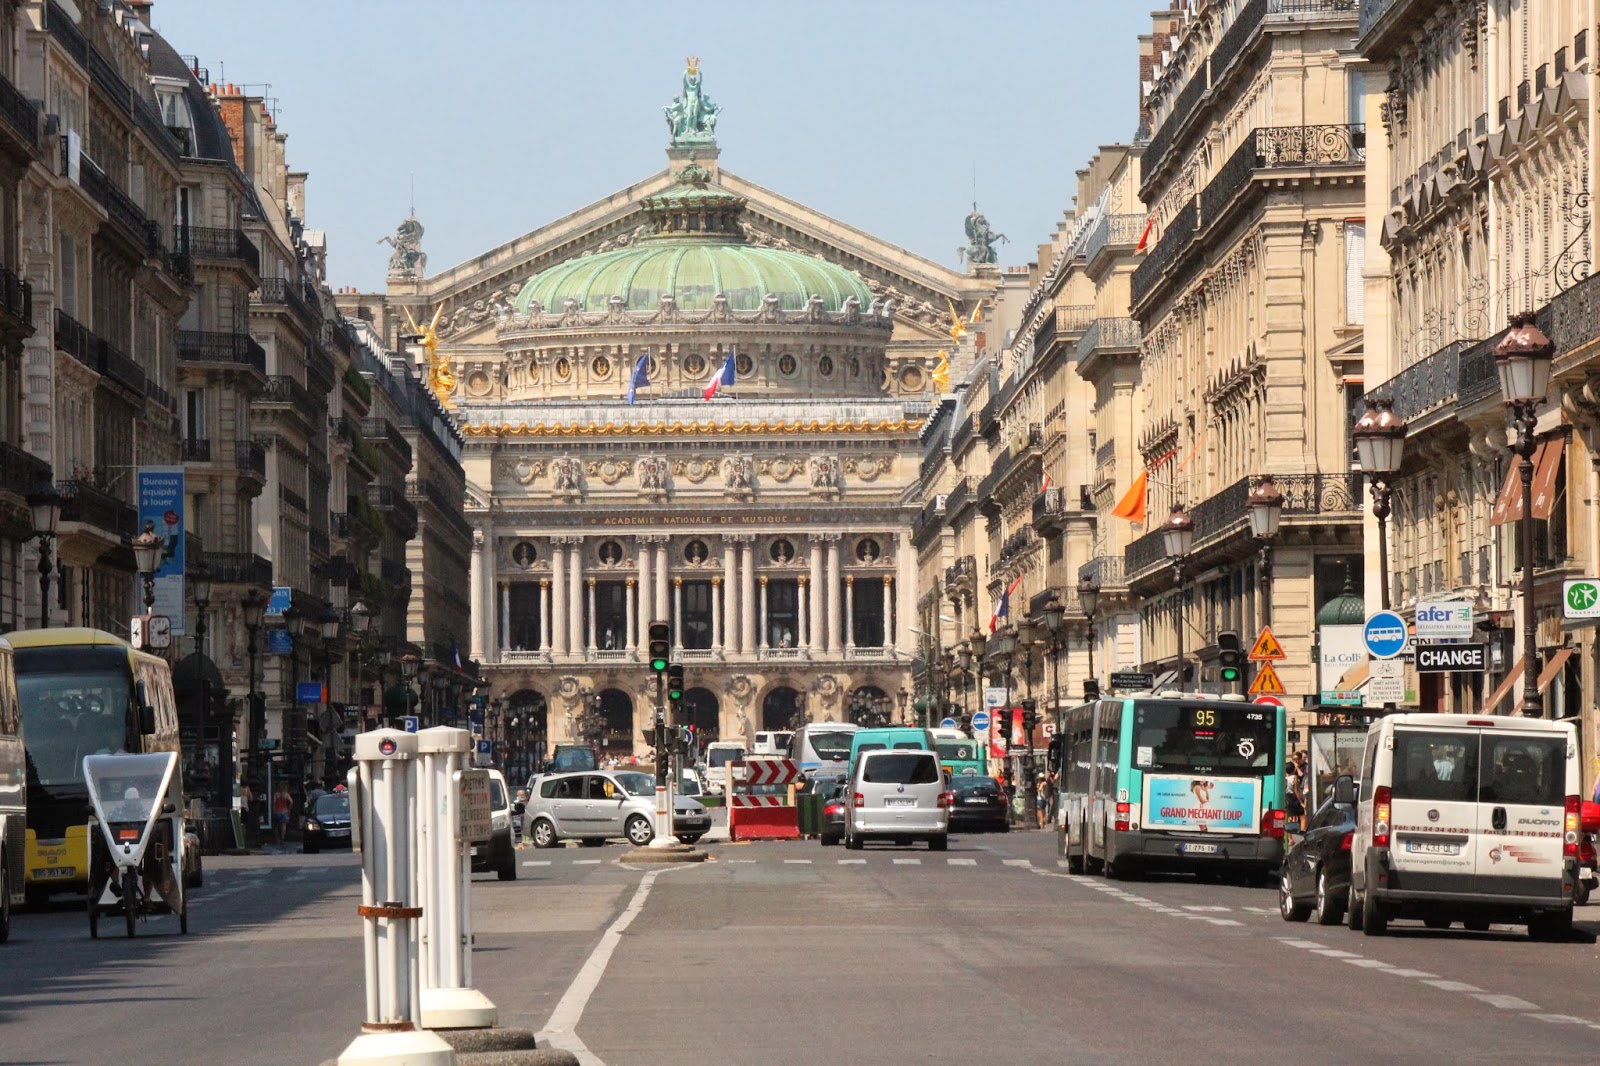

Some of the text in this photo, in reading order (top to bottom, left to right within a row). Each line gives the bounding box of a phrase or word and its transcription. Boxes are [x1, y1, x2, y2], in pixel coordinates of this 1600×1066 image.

[142, 478, 178, 486] Bureaux
[142, 488, 177, 497] équipés
[150, 498, 173, 506] louer
[604, 516, 788, 525] ACADEMIE NATIONALE DE MUSIQUE
[1417, 606, 1453, 622] afer
[1324, 654, 1336, 663] La
[1419, 650, 1482, 666] CHANGE
[1196, 710, 1215, 726] 95
[1246, 713, 1263, 721] 4735
[404, 720, 413, 732] P
[480, 742, 488, 754] P
[1119, 790, 1127, 801] 70
[1160, 807, 1187, 818] GRAND
[1223, 810, 1242, 821] LOUP
